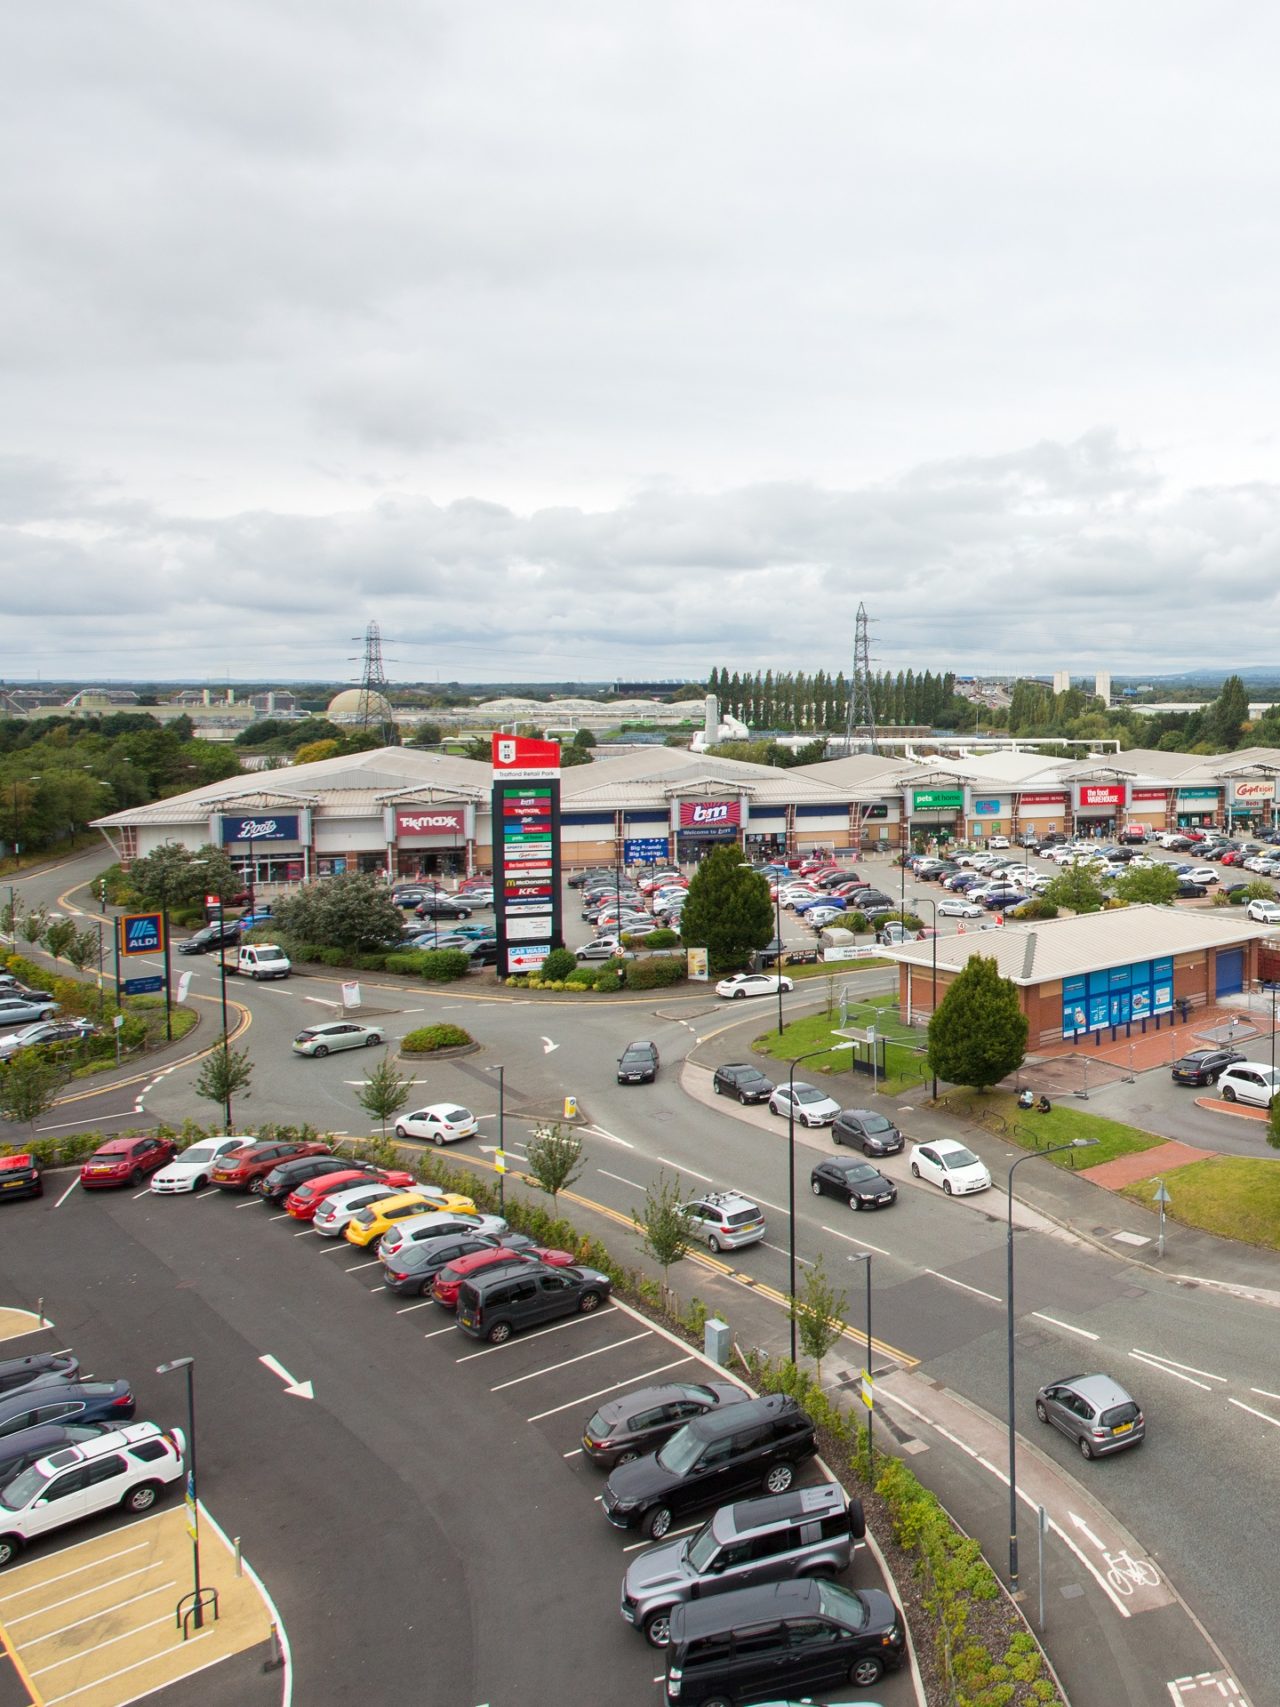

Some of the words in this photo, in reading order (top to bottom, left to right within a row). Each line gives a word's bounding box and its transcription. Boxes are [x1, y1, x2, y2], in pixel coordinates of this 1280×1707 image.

[1096, 788, 1109, 796] food
[916, 794, 933, 803] pets
[1087, 795, 1119, 803] WAREHOUSE
[237, 820, 277, 838] Boots
[129, 938, 158, 947] ALDI
